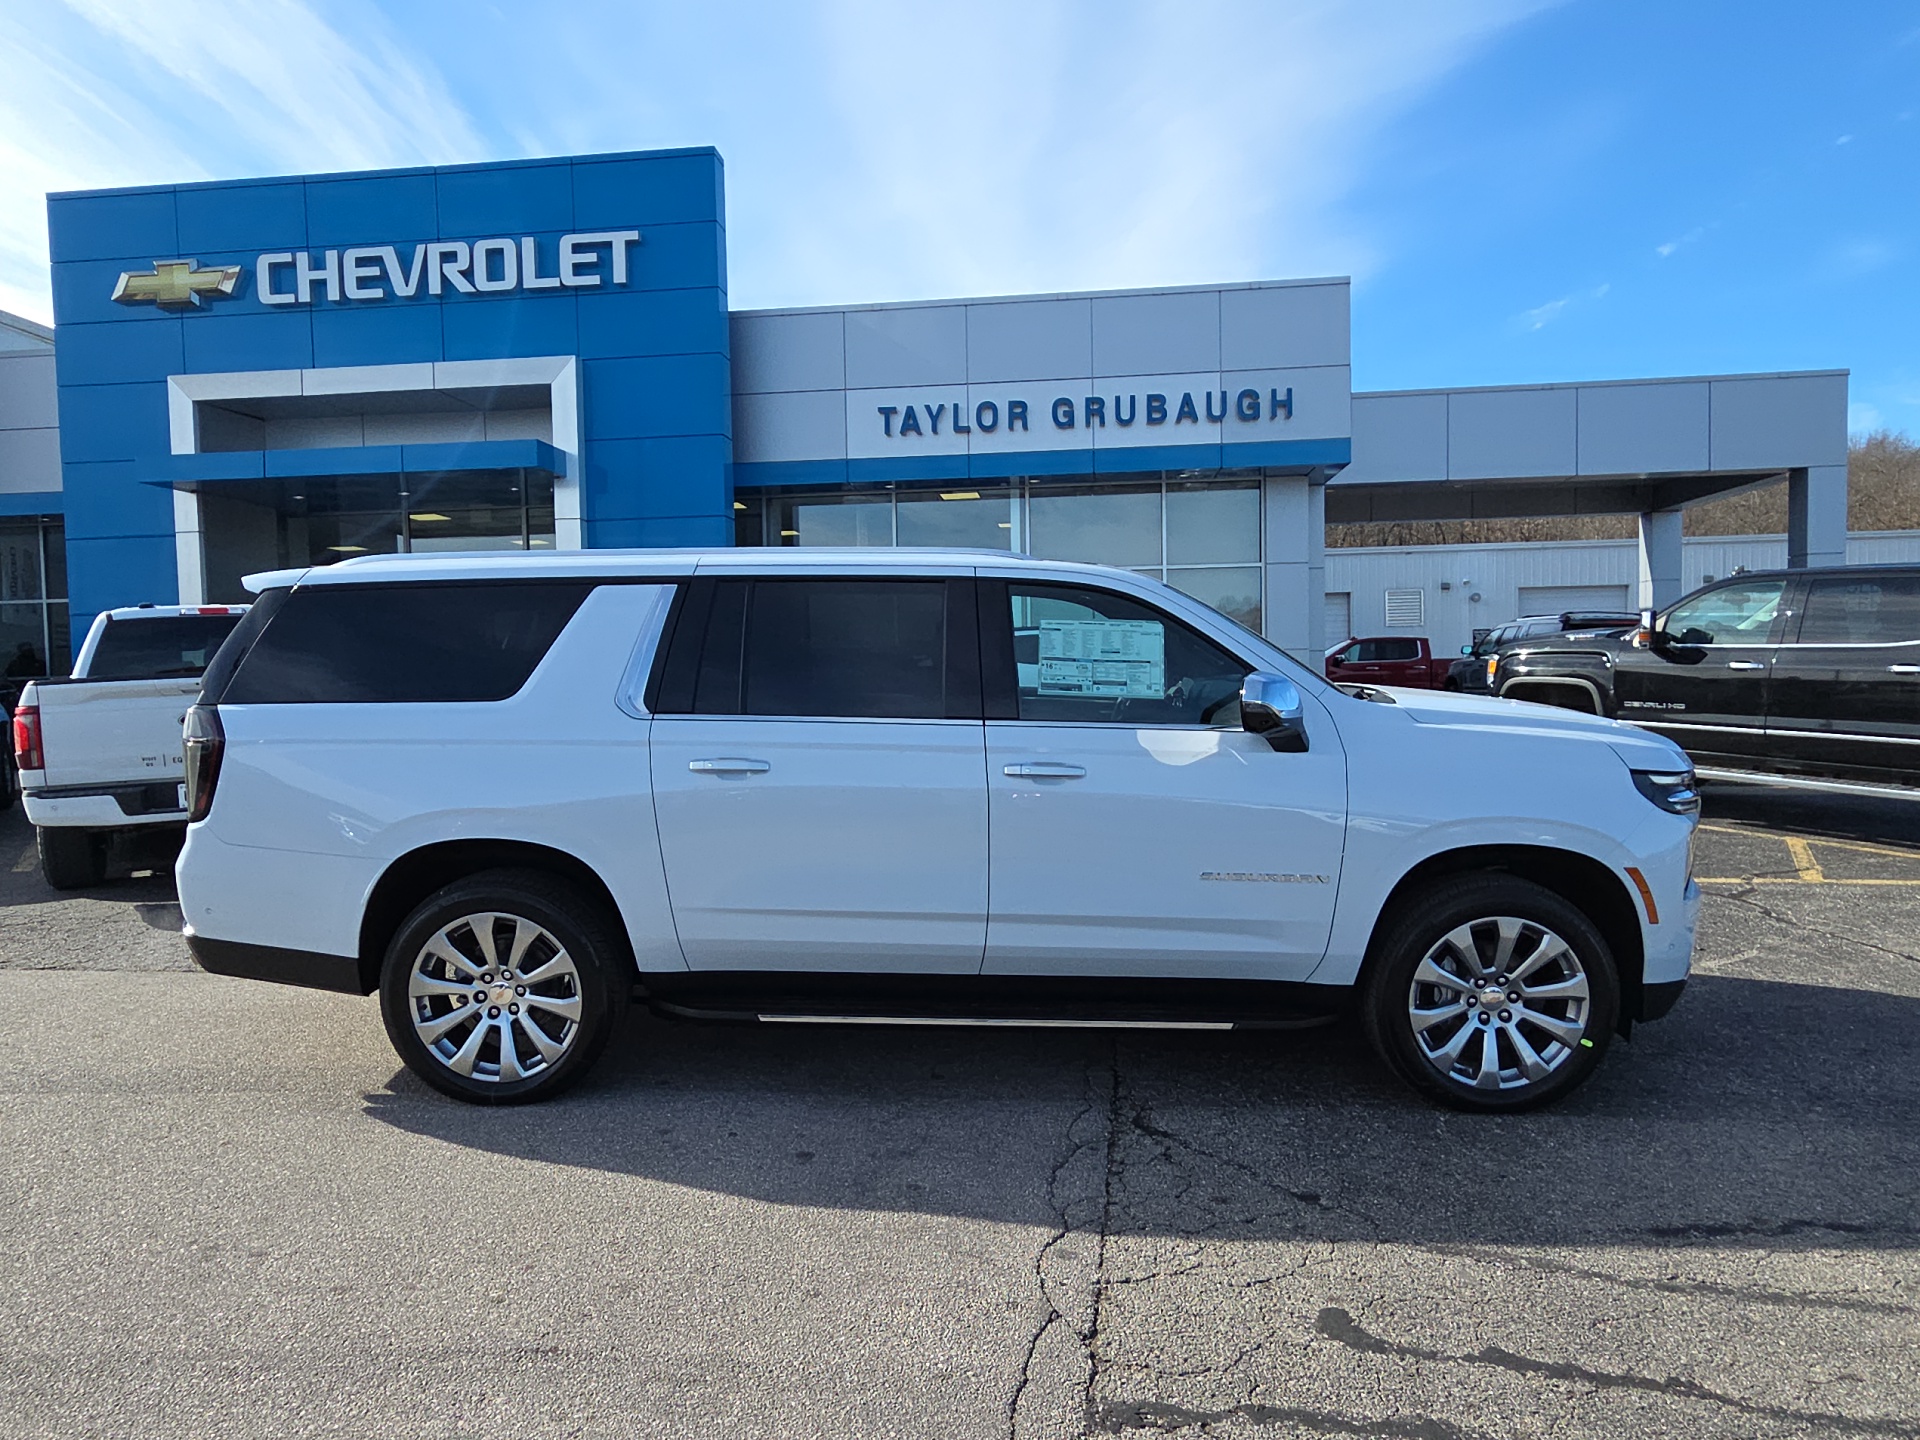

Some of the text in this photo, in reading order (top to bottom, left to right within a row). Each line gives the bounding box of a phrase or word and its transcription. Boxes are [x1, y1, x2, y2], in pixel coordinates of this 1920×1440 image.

[256, 230, 639, 305] CHEVROLET
[877, 387, 1293, 437] TAYLOR GRUBAUGH
[1623, 700, 1666, 709] DENALI
[1199, 871, 1330, 884] SUBURBAN
